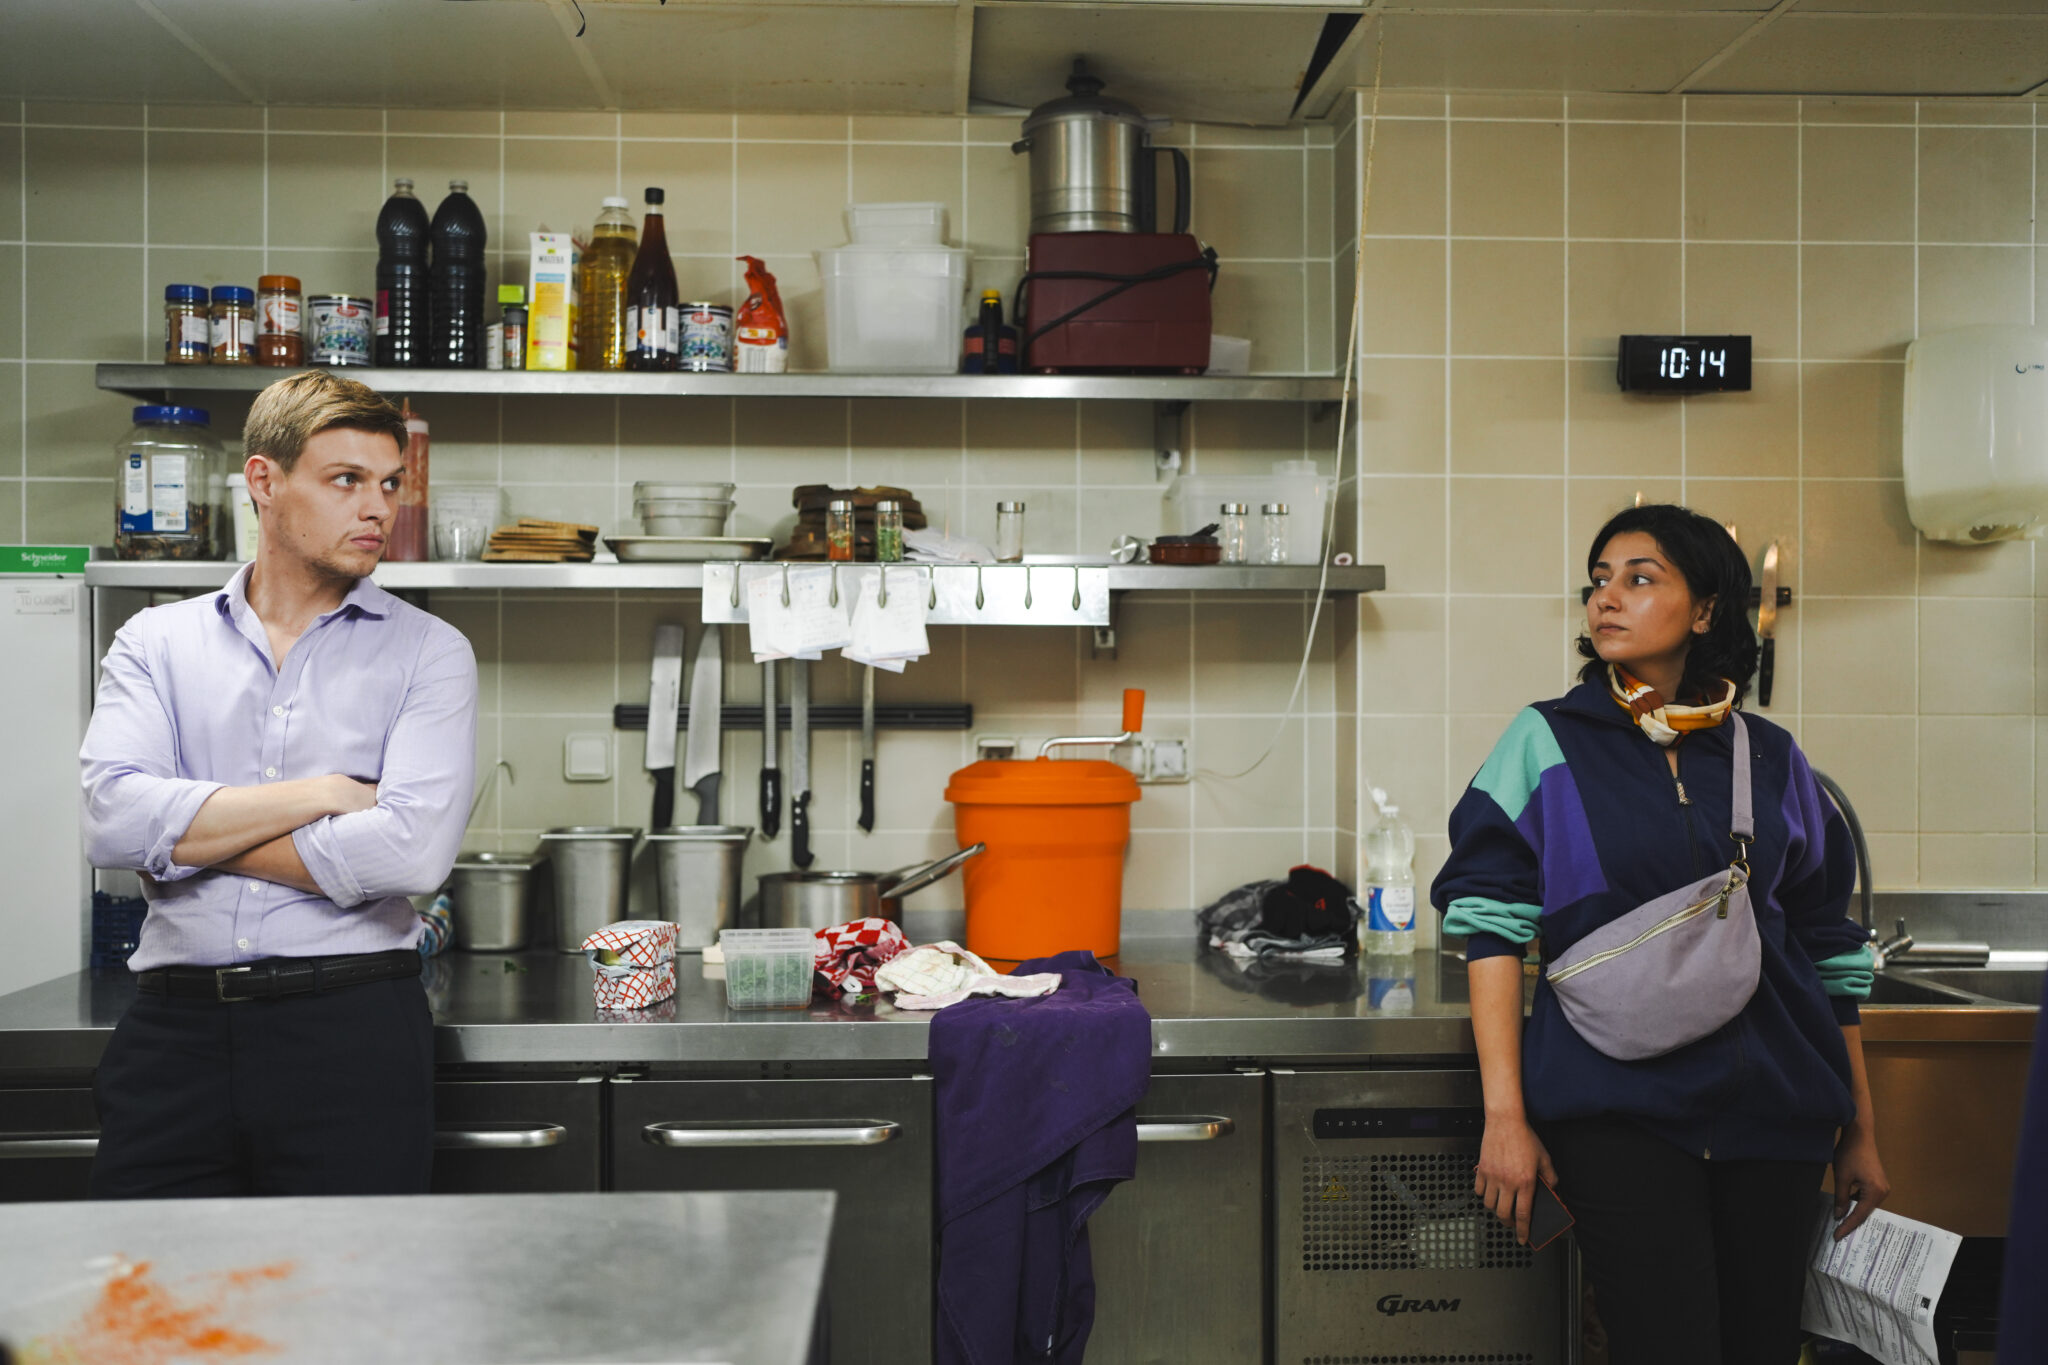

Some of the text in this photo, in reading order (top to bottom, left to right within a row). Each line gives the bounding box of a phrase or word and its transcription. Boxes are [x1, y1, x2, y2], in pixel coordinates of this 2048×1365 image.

[1660, 347, 1726, 379] 10:14
[21, 552, 67, 567] Schneider
[1376, 1294, 1462, 1316] GRAM
